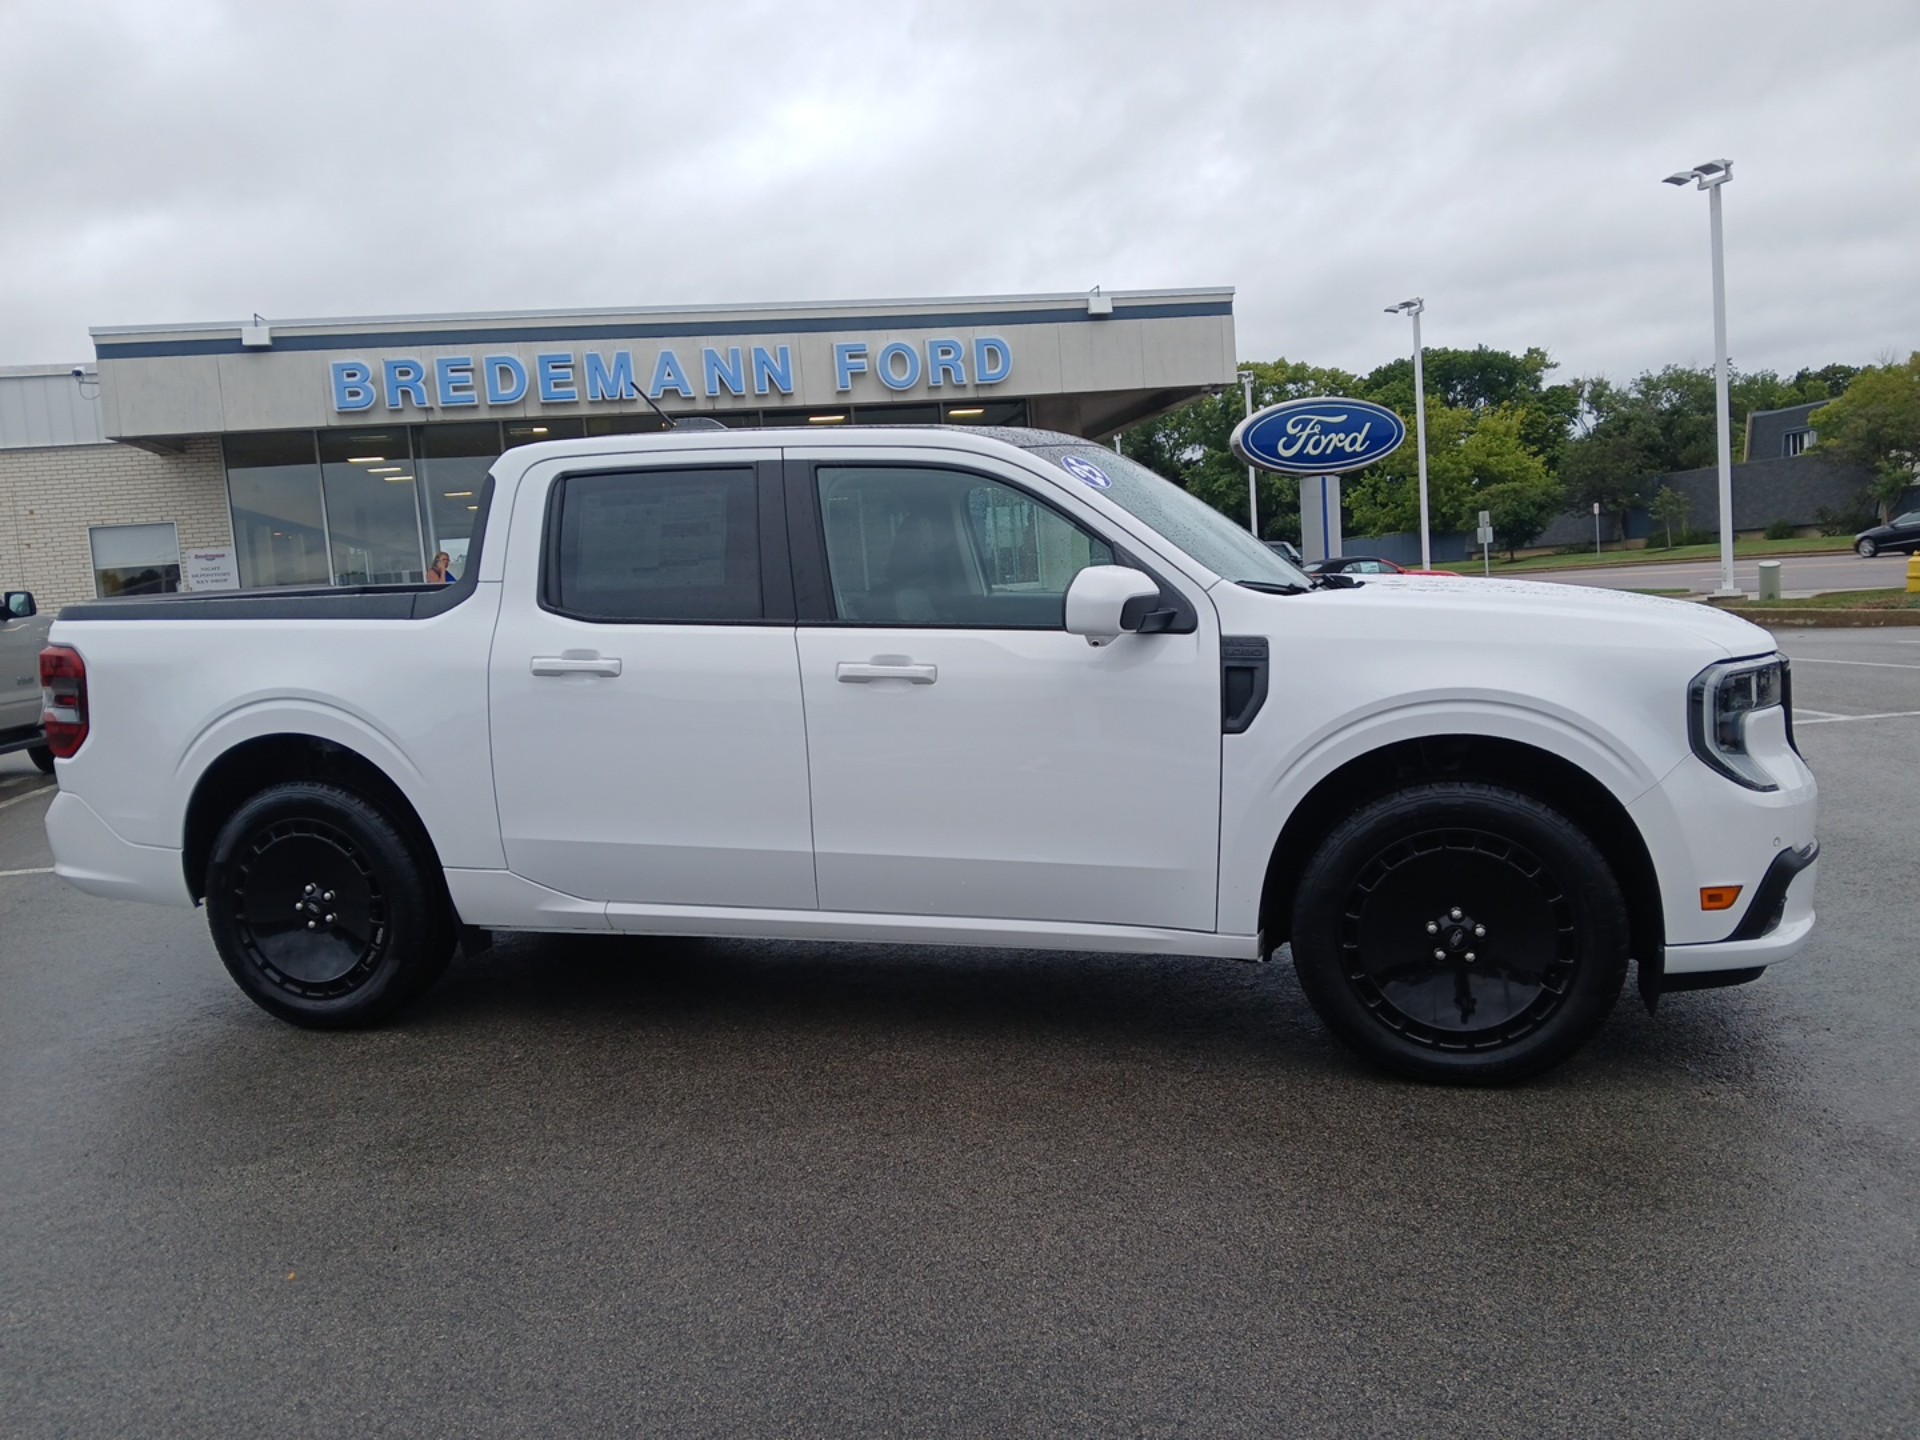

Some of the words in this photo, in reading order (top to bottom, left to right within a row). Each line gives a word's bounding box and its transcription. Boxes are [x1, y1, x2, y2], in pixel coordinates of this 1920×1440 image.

[329, 344, 795, 412] BREDEMANN
[833, 335, 1013, 392] FORD
[1277, 414, 1372, 458] Ford
